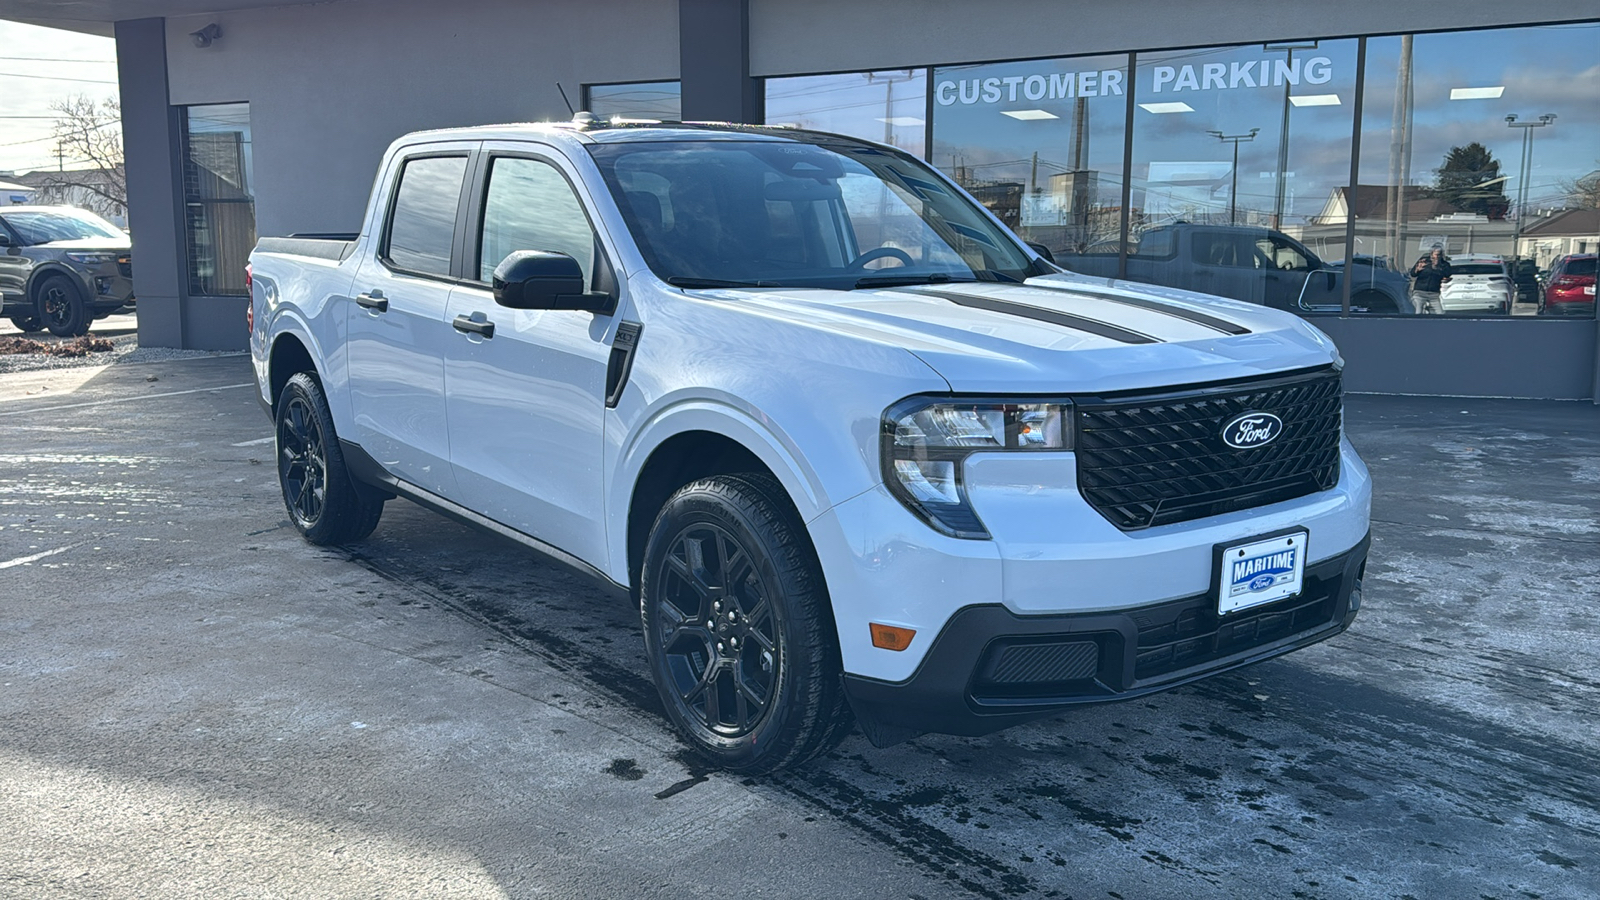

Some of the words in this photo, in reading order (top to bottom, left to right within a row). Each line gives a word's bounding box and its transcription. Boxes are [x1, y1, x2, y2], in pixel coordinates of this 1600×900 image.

[936, 69, 1124, 106] CUSTOMER
[1152, 56, 1333, 93] PARKING
[615, 331, 636, 342] XLT
[1234, 418, 1273, 444] Ford
[1233, 550, 1294, 583] MARITIME
[1253, 577, 1271, 589] Ford
